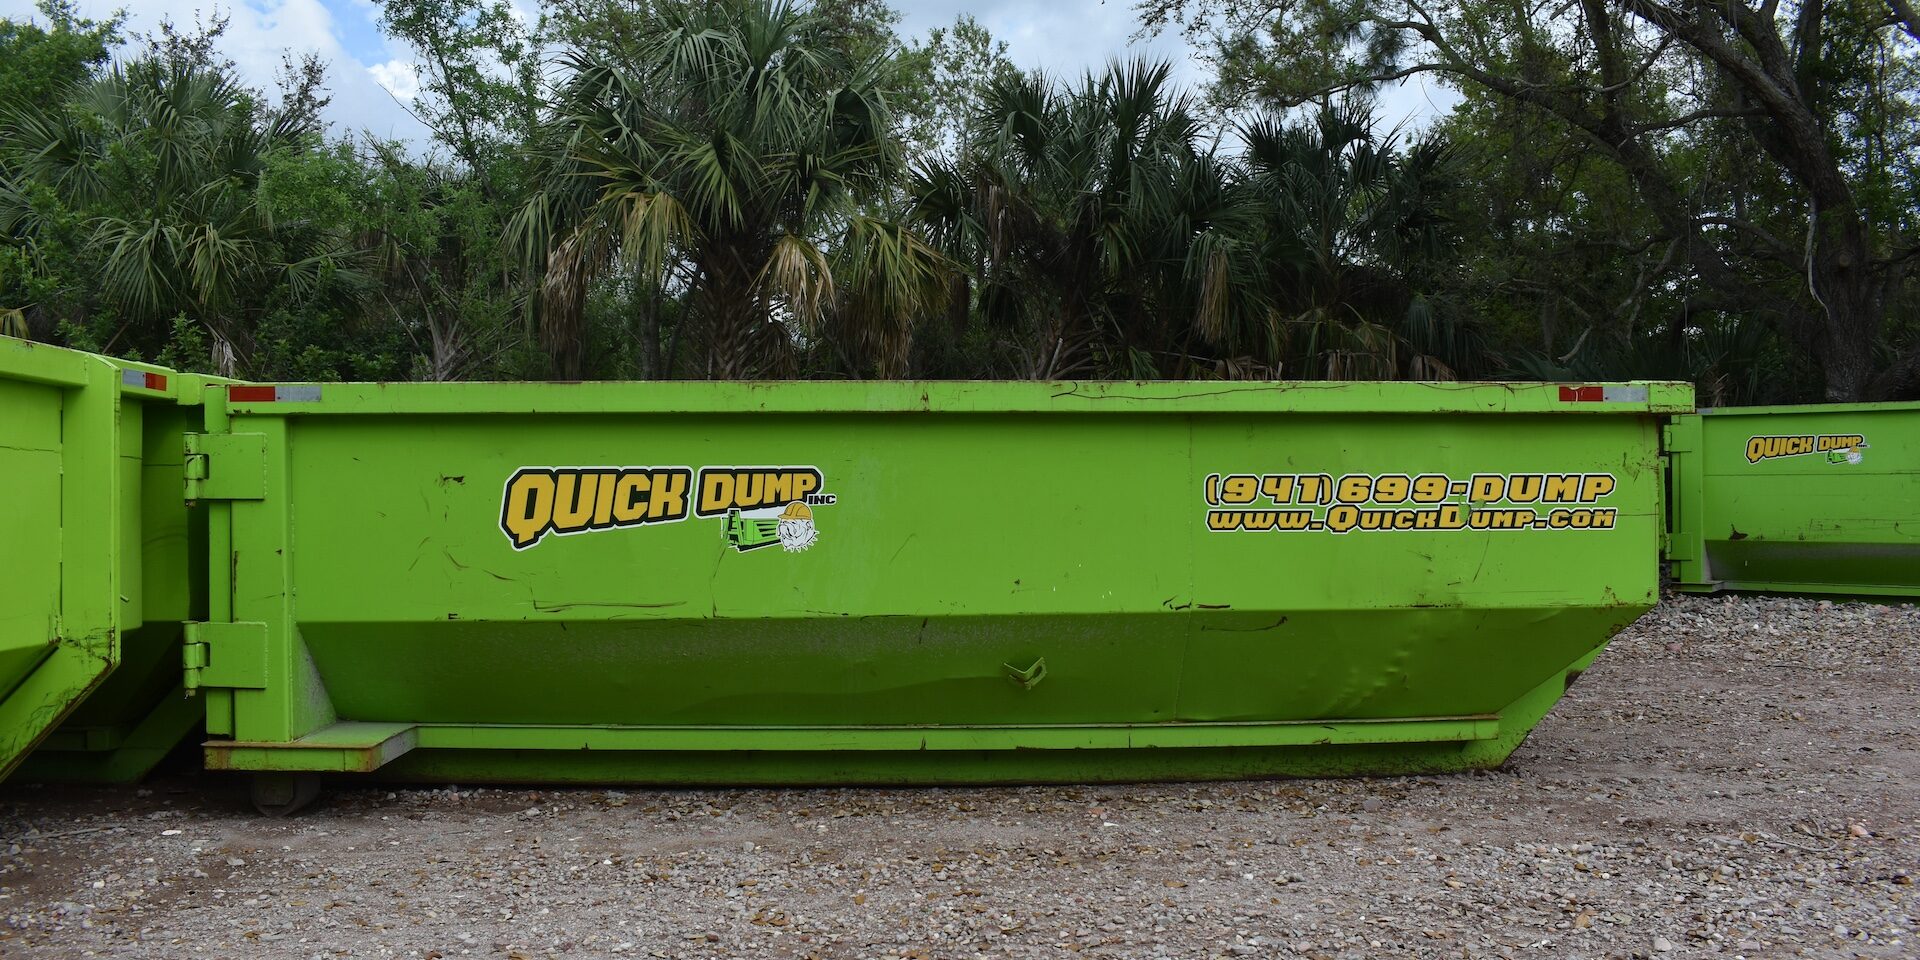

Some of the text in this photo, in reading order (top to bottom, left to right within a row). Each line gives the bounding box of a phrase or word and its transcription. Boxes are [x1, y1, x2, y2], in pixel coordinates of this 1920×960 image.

[1746, 435, 1863, 463] QUICK DUMP
[503, 469, 836, 548] QUICK DUMP INC
